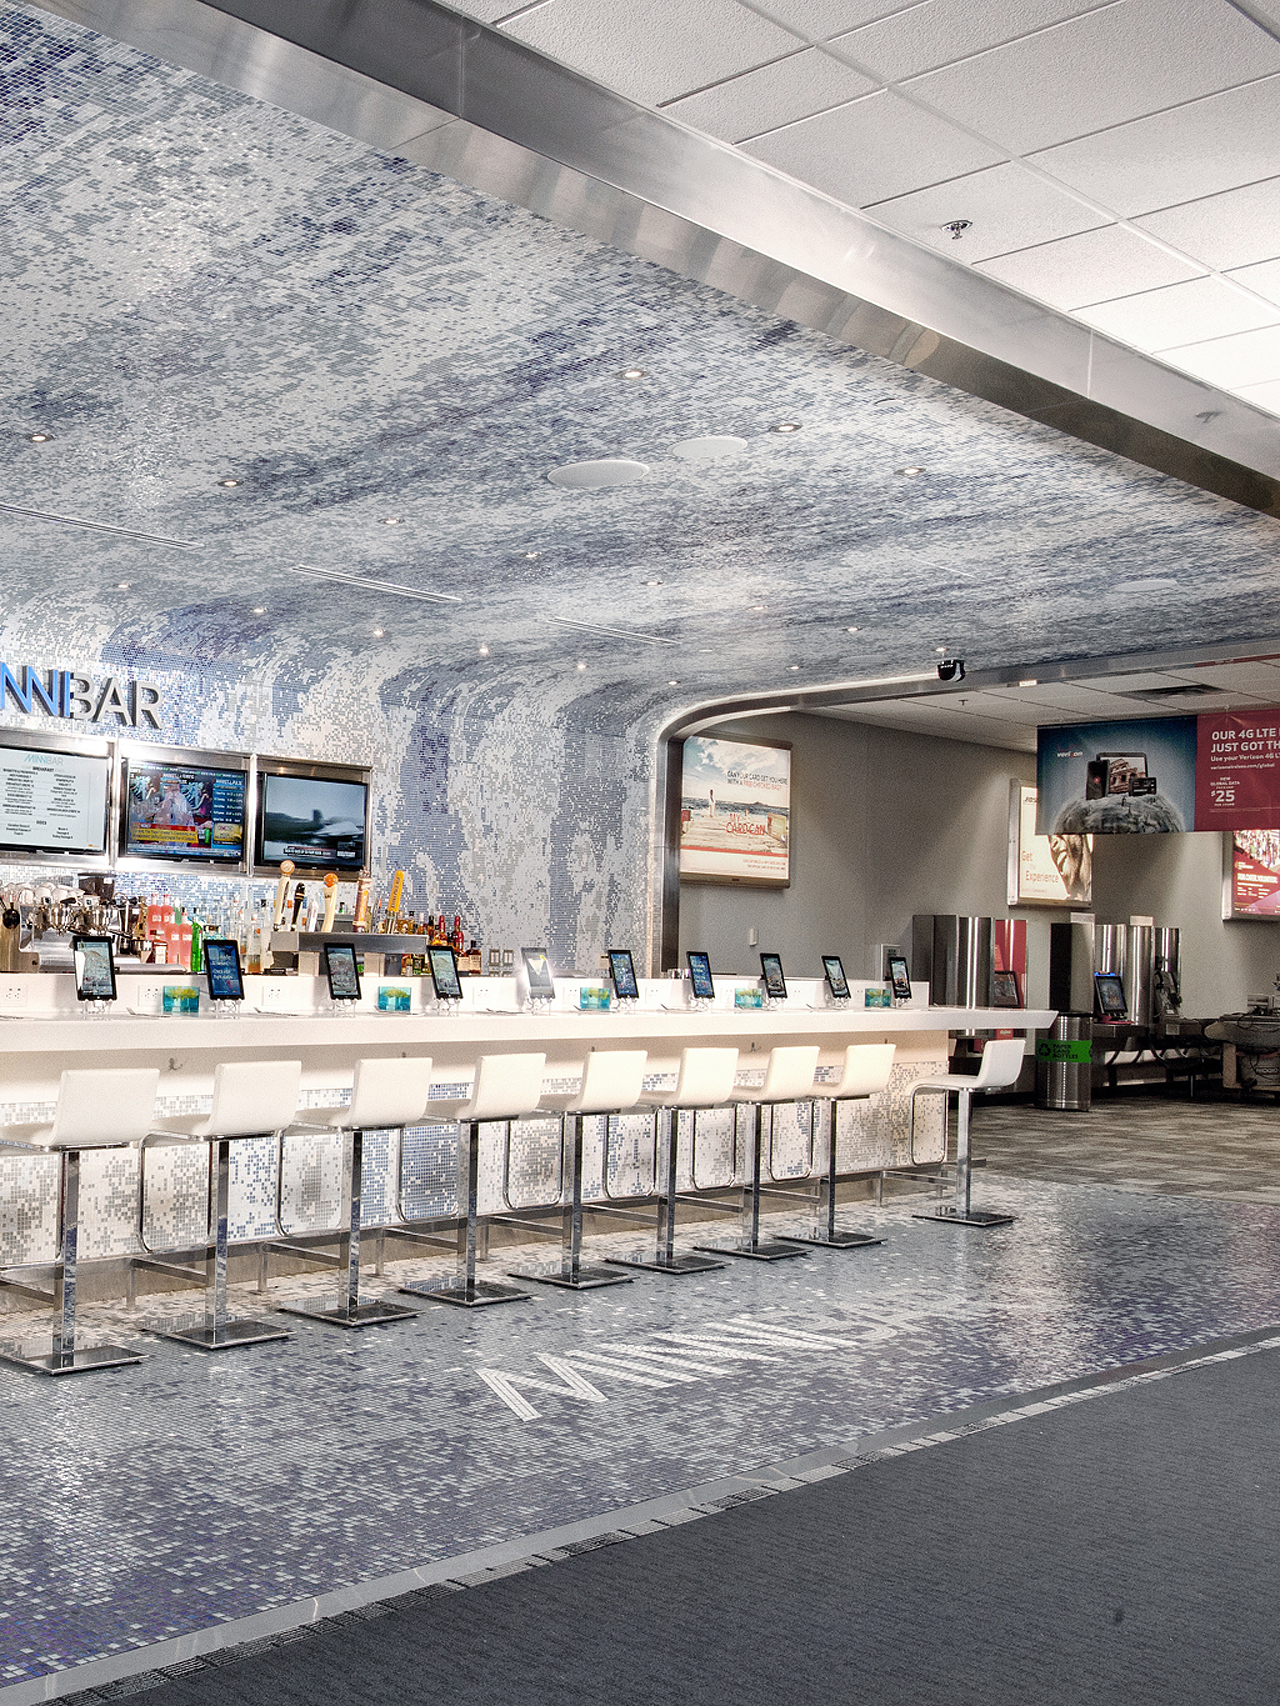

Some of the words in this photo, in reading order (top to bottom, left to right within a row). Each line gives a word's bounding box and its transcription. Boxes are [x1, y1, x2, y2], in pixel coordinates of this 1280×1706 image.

[1211, 731, 1236, 740] OUR
[1238, 729, 1254, 739] 4G
[1256, 728, 1277, 738] LTE
[1211, 742, 1239, 753] JUST
[1240, 741, 1265, 751] GOT
[1210, 790, 1235, 802] $25
[1025, 870, 1059, 884] Experience
